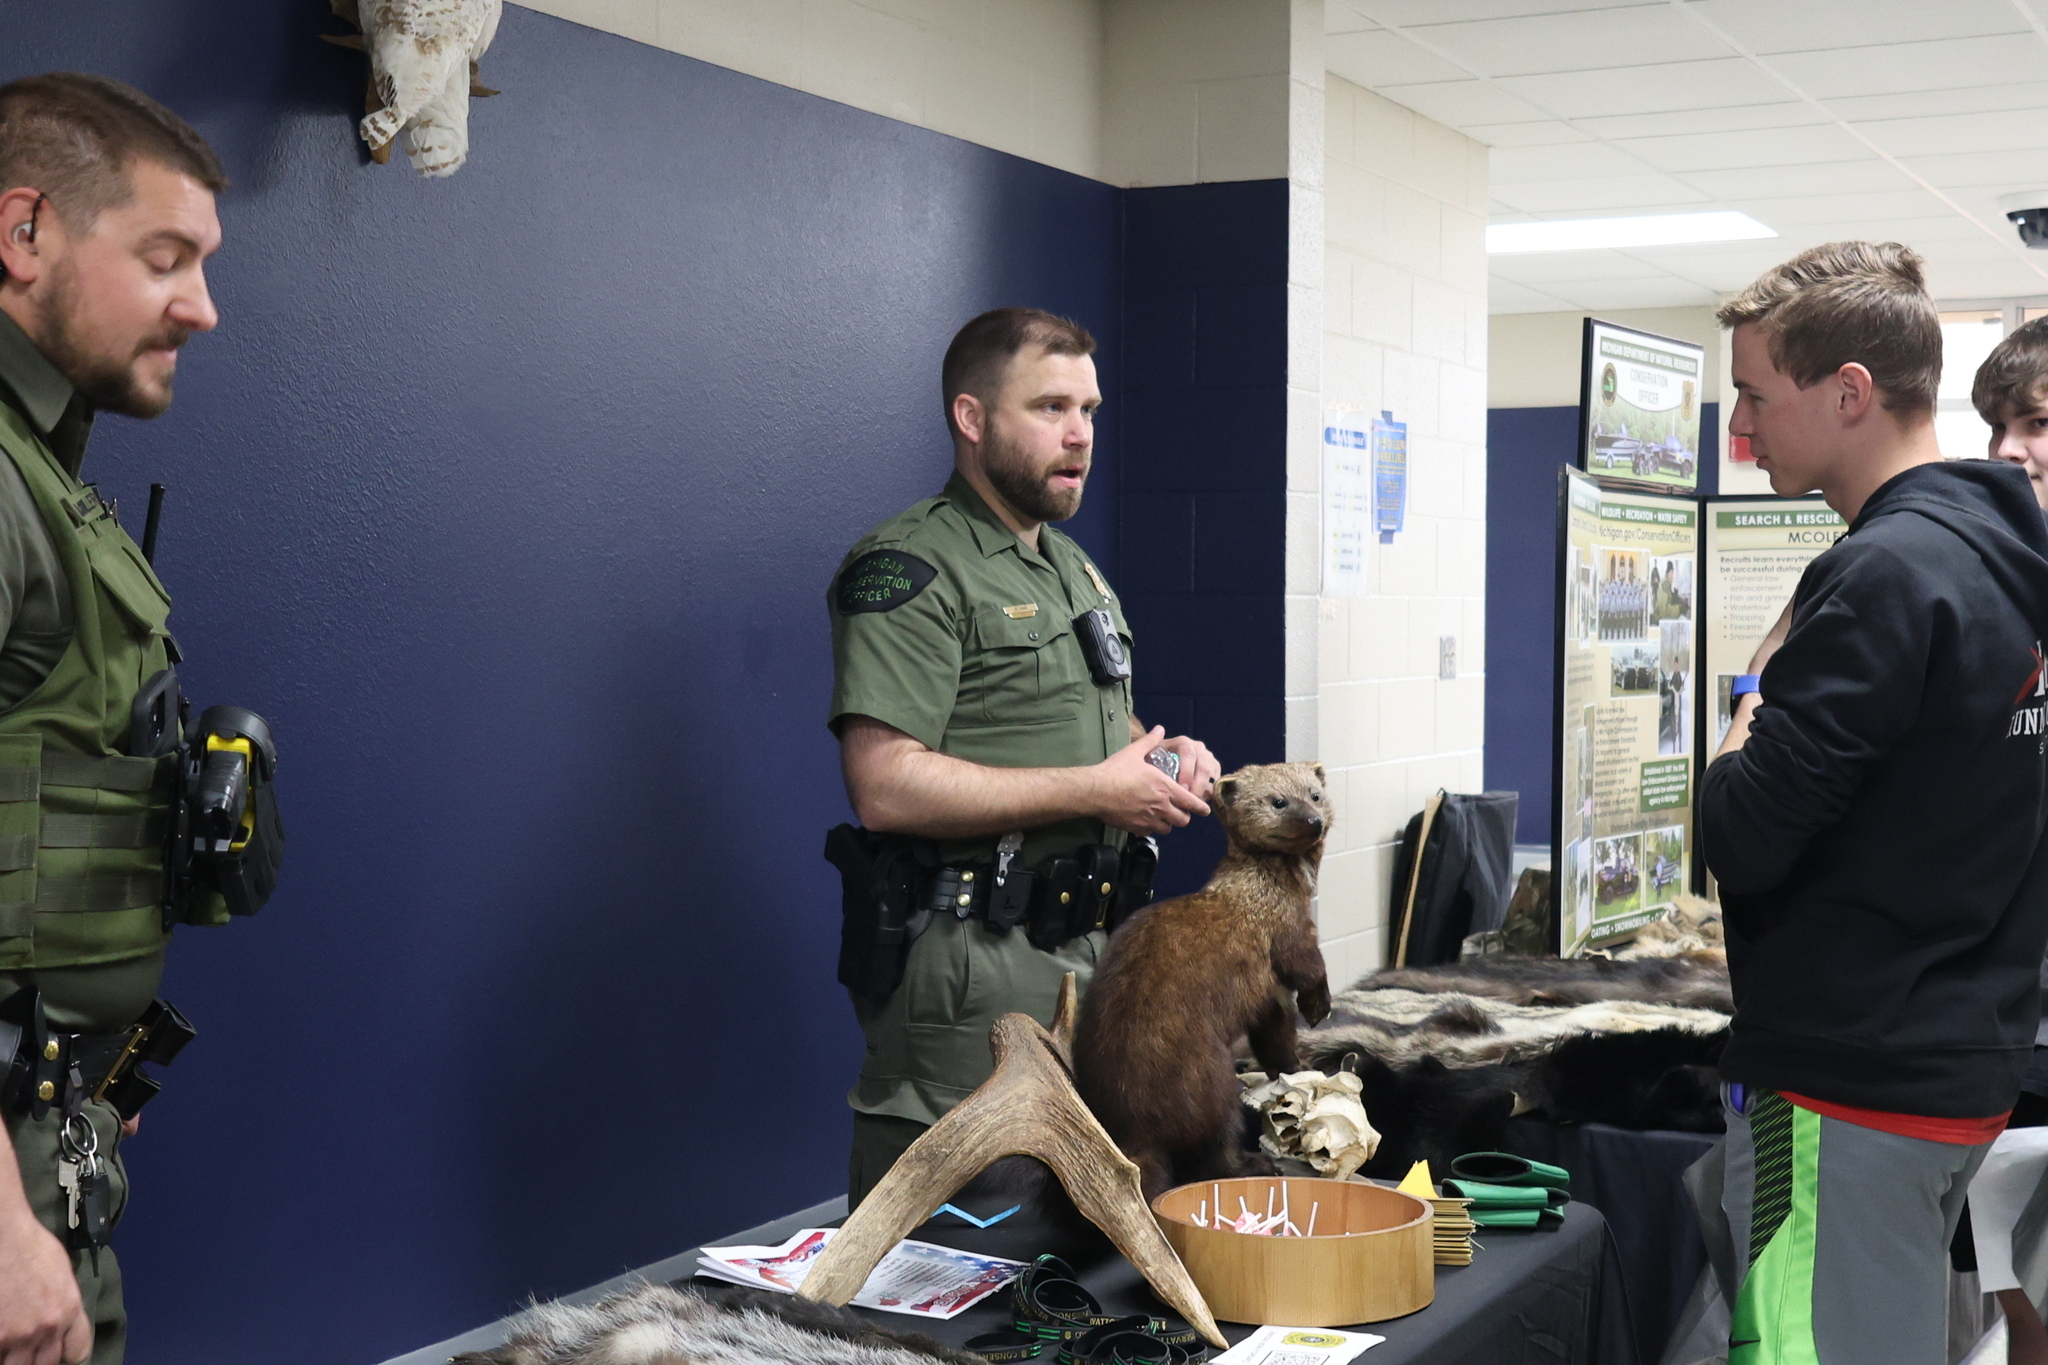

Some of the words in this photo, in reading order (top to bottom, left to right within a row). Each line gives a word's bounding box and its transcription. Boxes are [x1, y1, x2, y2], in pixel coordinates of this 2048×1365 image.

[1631, 368, 1668, 388] CONSERVATION
[1638, 389, 1659, 405] OFFICER
[1602, 507, 1621, 519] WILDLIFE
[1626, 508, 1653, 522] RECREATION
[1658, 512, 1672, 523] WATER
[1672, 513, 1687, 524] SAFETY
[1735, 515, 1780, 526] SEARCH
[1784, 515, 1793, 525] &
[1796, 513, 1840, 525] RESCUE
[1788, 531, 1847, 543] MCOLE
[1776, 555, 1816, 565] everythin
[1733, 565, 1774, 573] successful
[1776, 565, 1802, 574] during
[1730, 575, 1764, 583] General
[1730, 594, 1745, 602] Fish
[1746, 594, 1762, 602] and
[1765, 596, 1789, 604] game
[1730, 604, 1771, 612] Waterfowl
[1730, 614, 1765, 623] Trapping
[1730, 623, 1763, 631] Firearms
[1730, 633, 1767, 641] Snowmo
[1591, 924, 1610, 939] OATING
[1614, 914, 1651, 933] SNOWMOBILING
